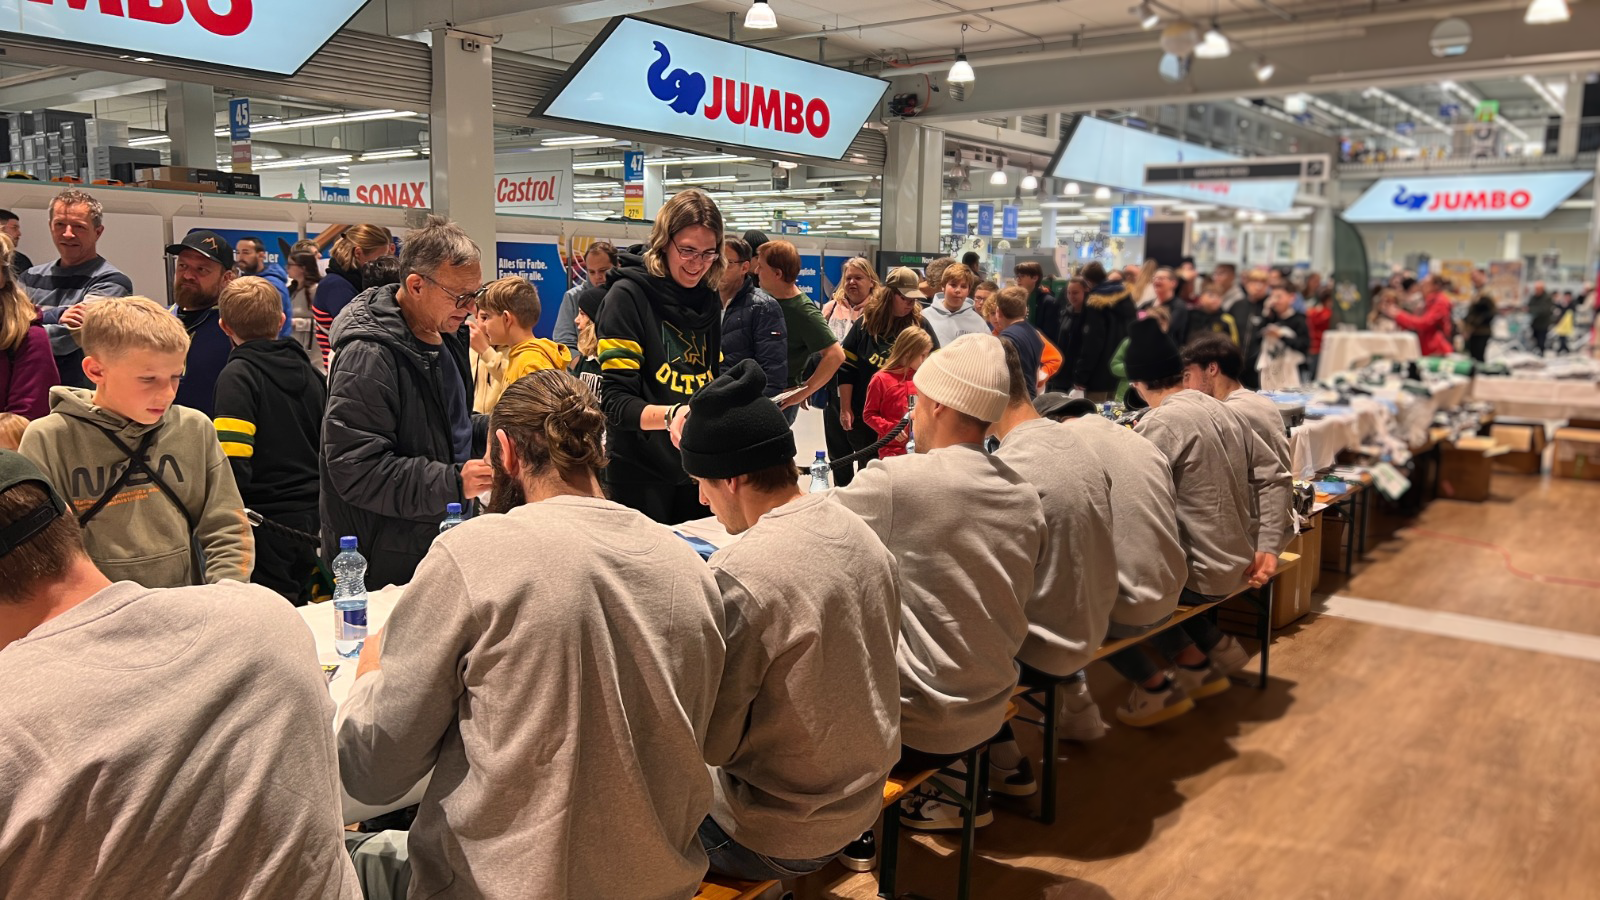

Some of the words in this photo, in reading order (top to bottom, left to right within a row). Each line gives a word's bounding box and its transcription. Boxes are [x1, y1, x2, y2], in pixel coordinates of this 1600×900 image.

[235, 103, 248, 126] 45
[704, 75, 830, 138] JUMBO
[630, 154, 643, 171] 47
[356, 182, 426, 208] SONAX
[497, 176, 556, 203] Castrol
[1428, 189, 1532, 212] JUMBO
[498, 257, 515, 269] Alles
[516, 258, 526, 269] für
[527, 258, 548, 269] Farbe.
[518, 270, 529, 280] für
[529, 270, 544, 281] alle.
